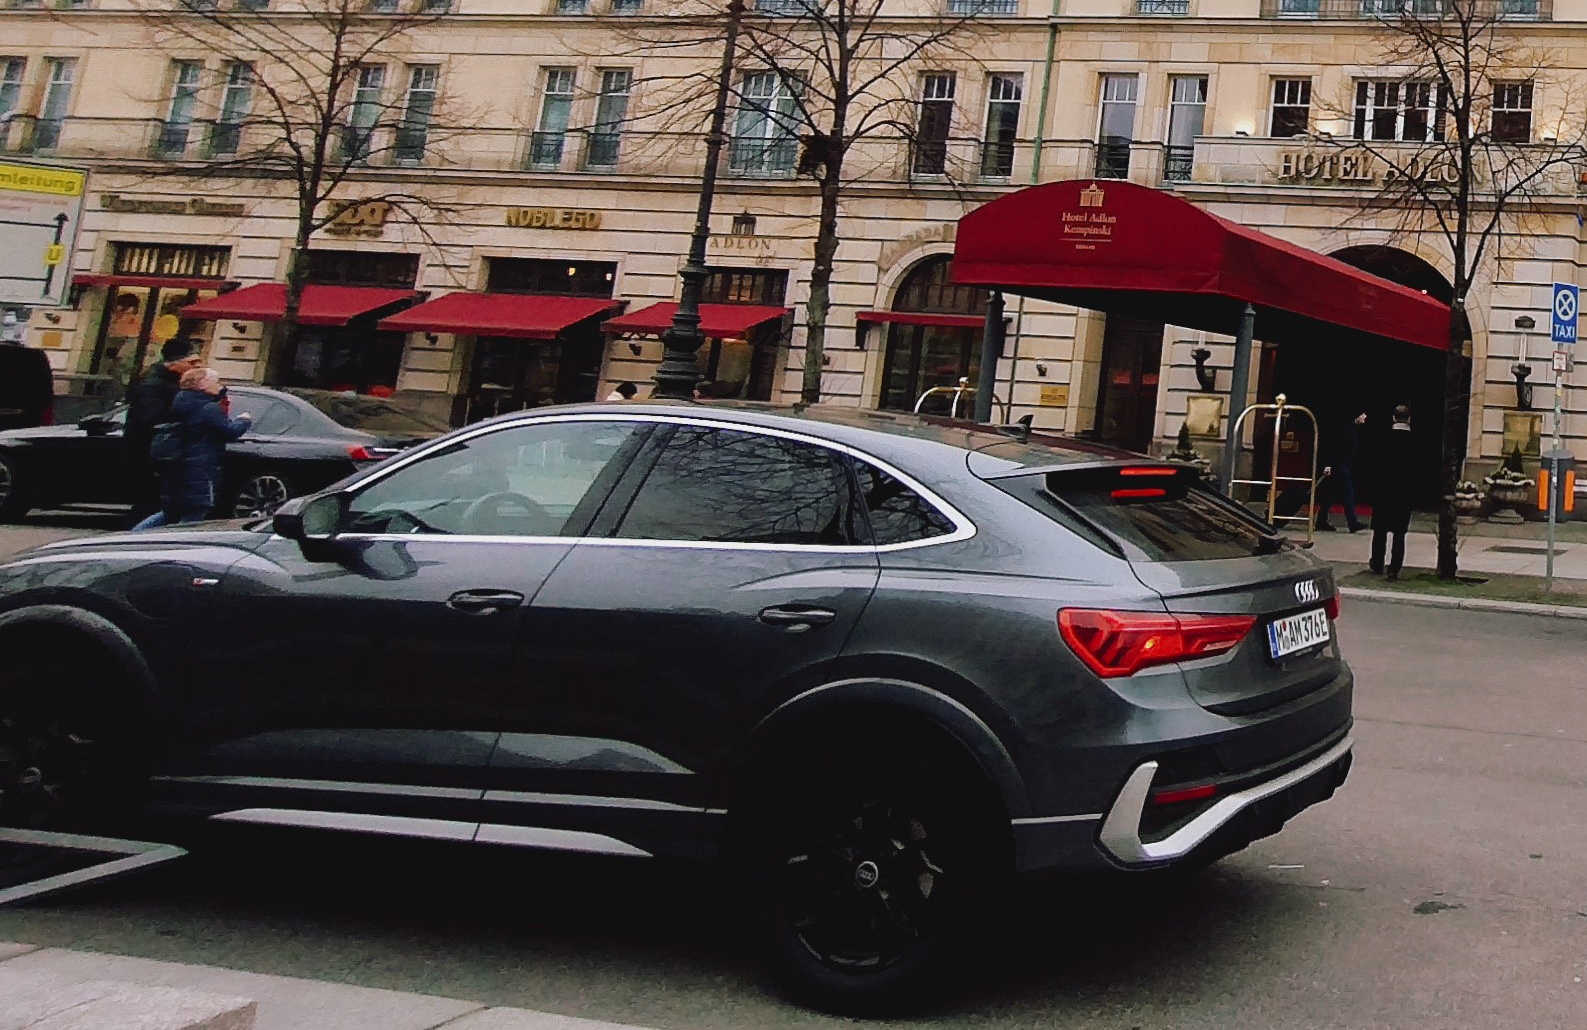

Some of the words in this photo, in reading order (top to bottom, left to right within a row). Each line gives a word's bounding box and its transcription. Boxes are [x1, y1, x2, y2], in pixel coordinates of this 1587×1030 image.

[1278, 152, 1373, 181] HOTEL
[1062, 212, 1088, 222] Hotel
[1089, 213, 1117, 224] Adlon
[1064, 224, 1112, 237] Kempinski
[709, 236, 772, 250] ADLON
[1554, 323, 1575, 339] TAXI
